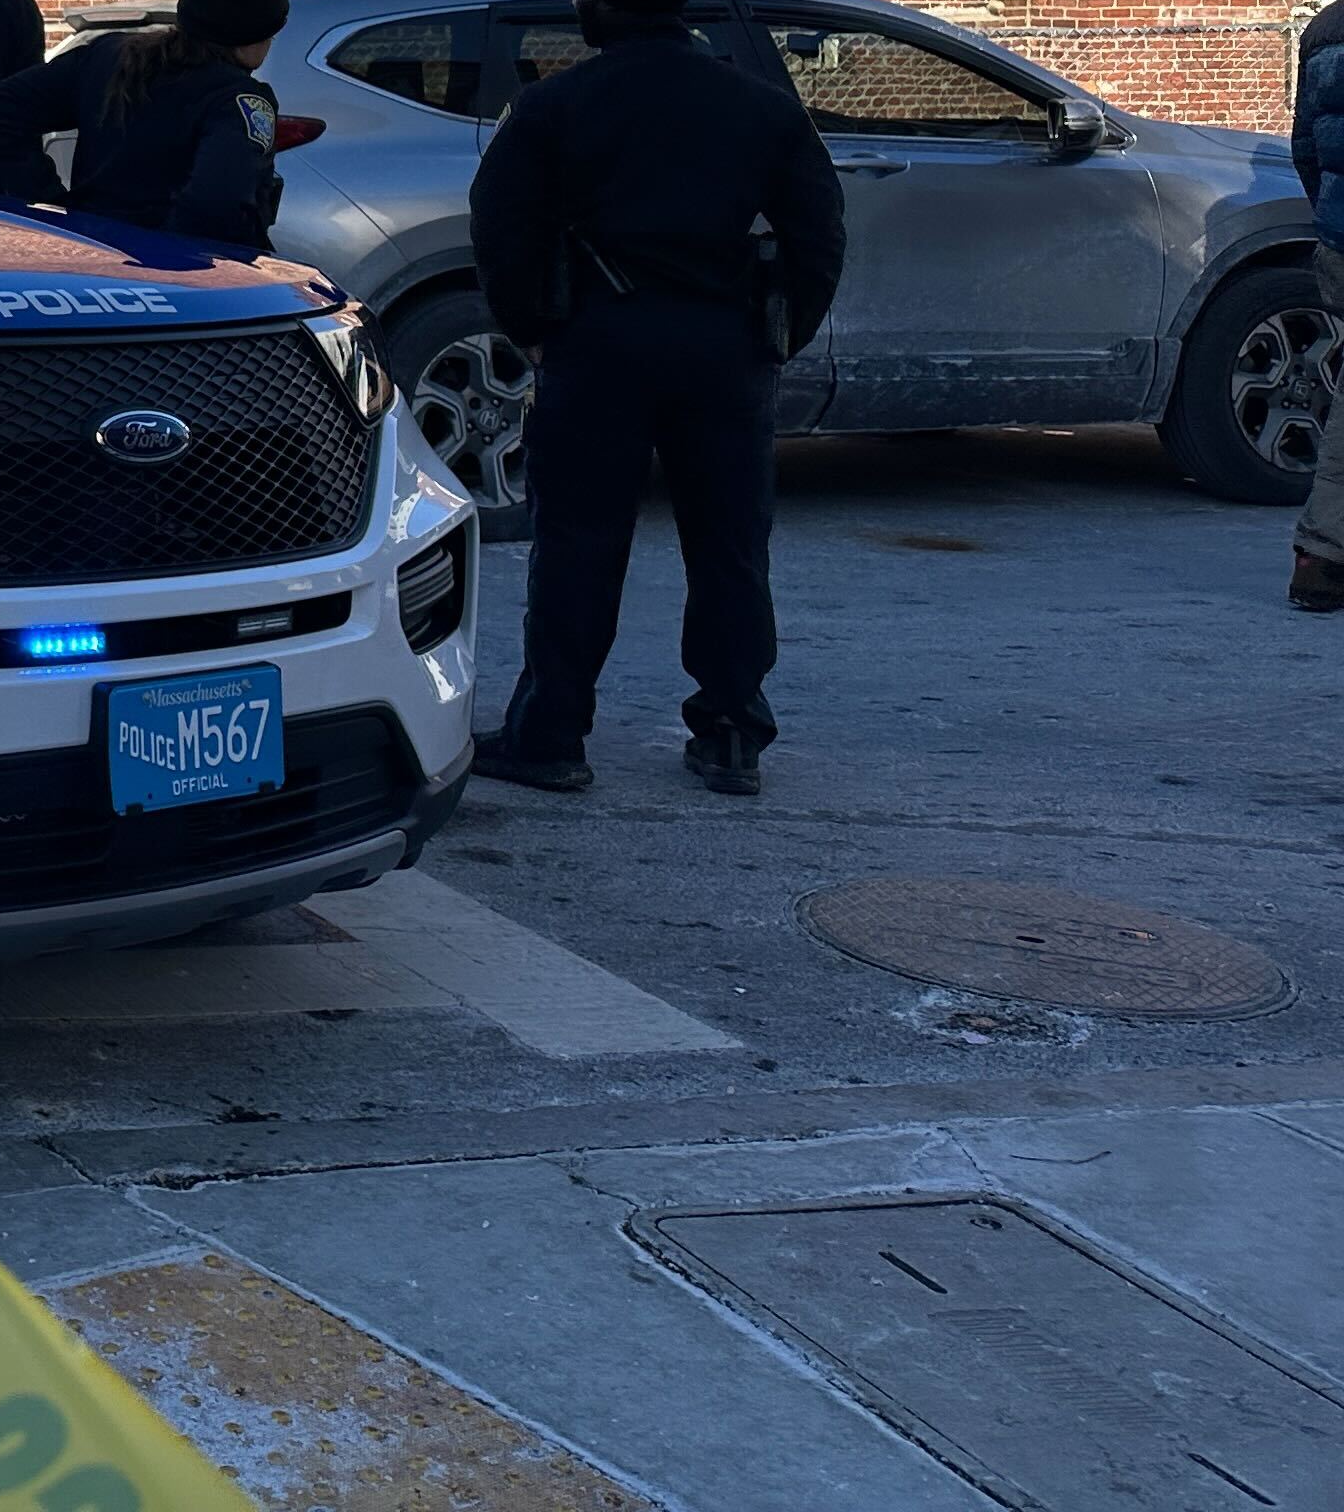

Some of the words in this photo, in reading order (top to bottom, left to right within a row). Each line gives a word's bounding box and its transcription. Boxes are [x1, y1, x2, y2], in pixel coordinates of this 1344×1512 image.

[123, 420, 173, 449] Ford
[149, 681, 243, 708] Massachusetts
[119, 721, 176, 771] POLICE
[177, 699, 270, 771] M567
[173, 772, 229, 796] OFFICIAL
